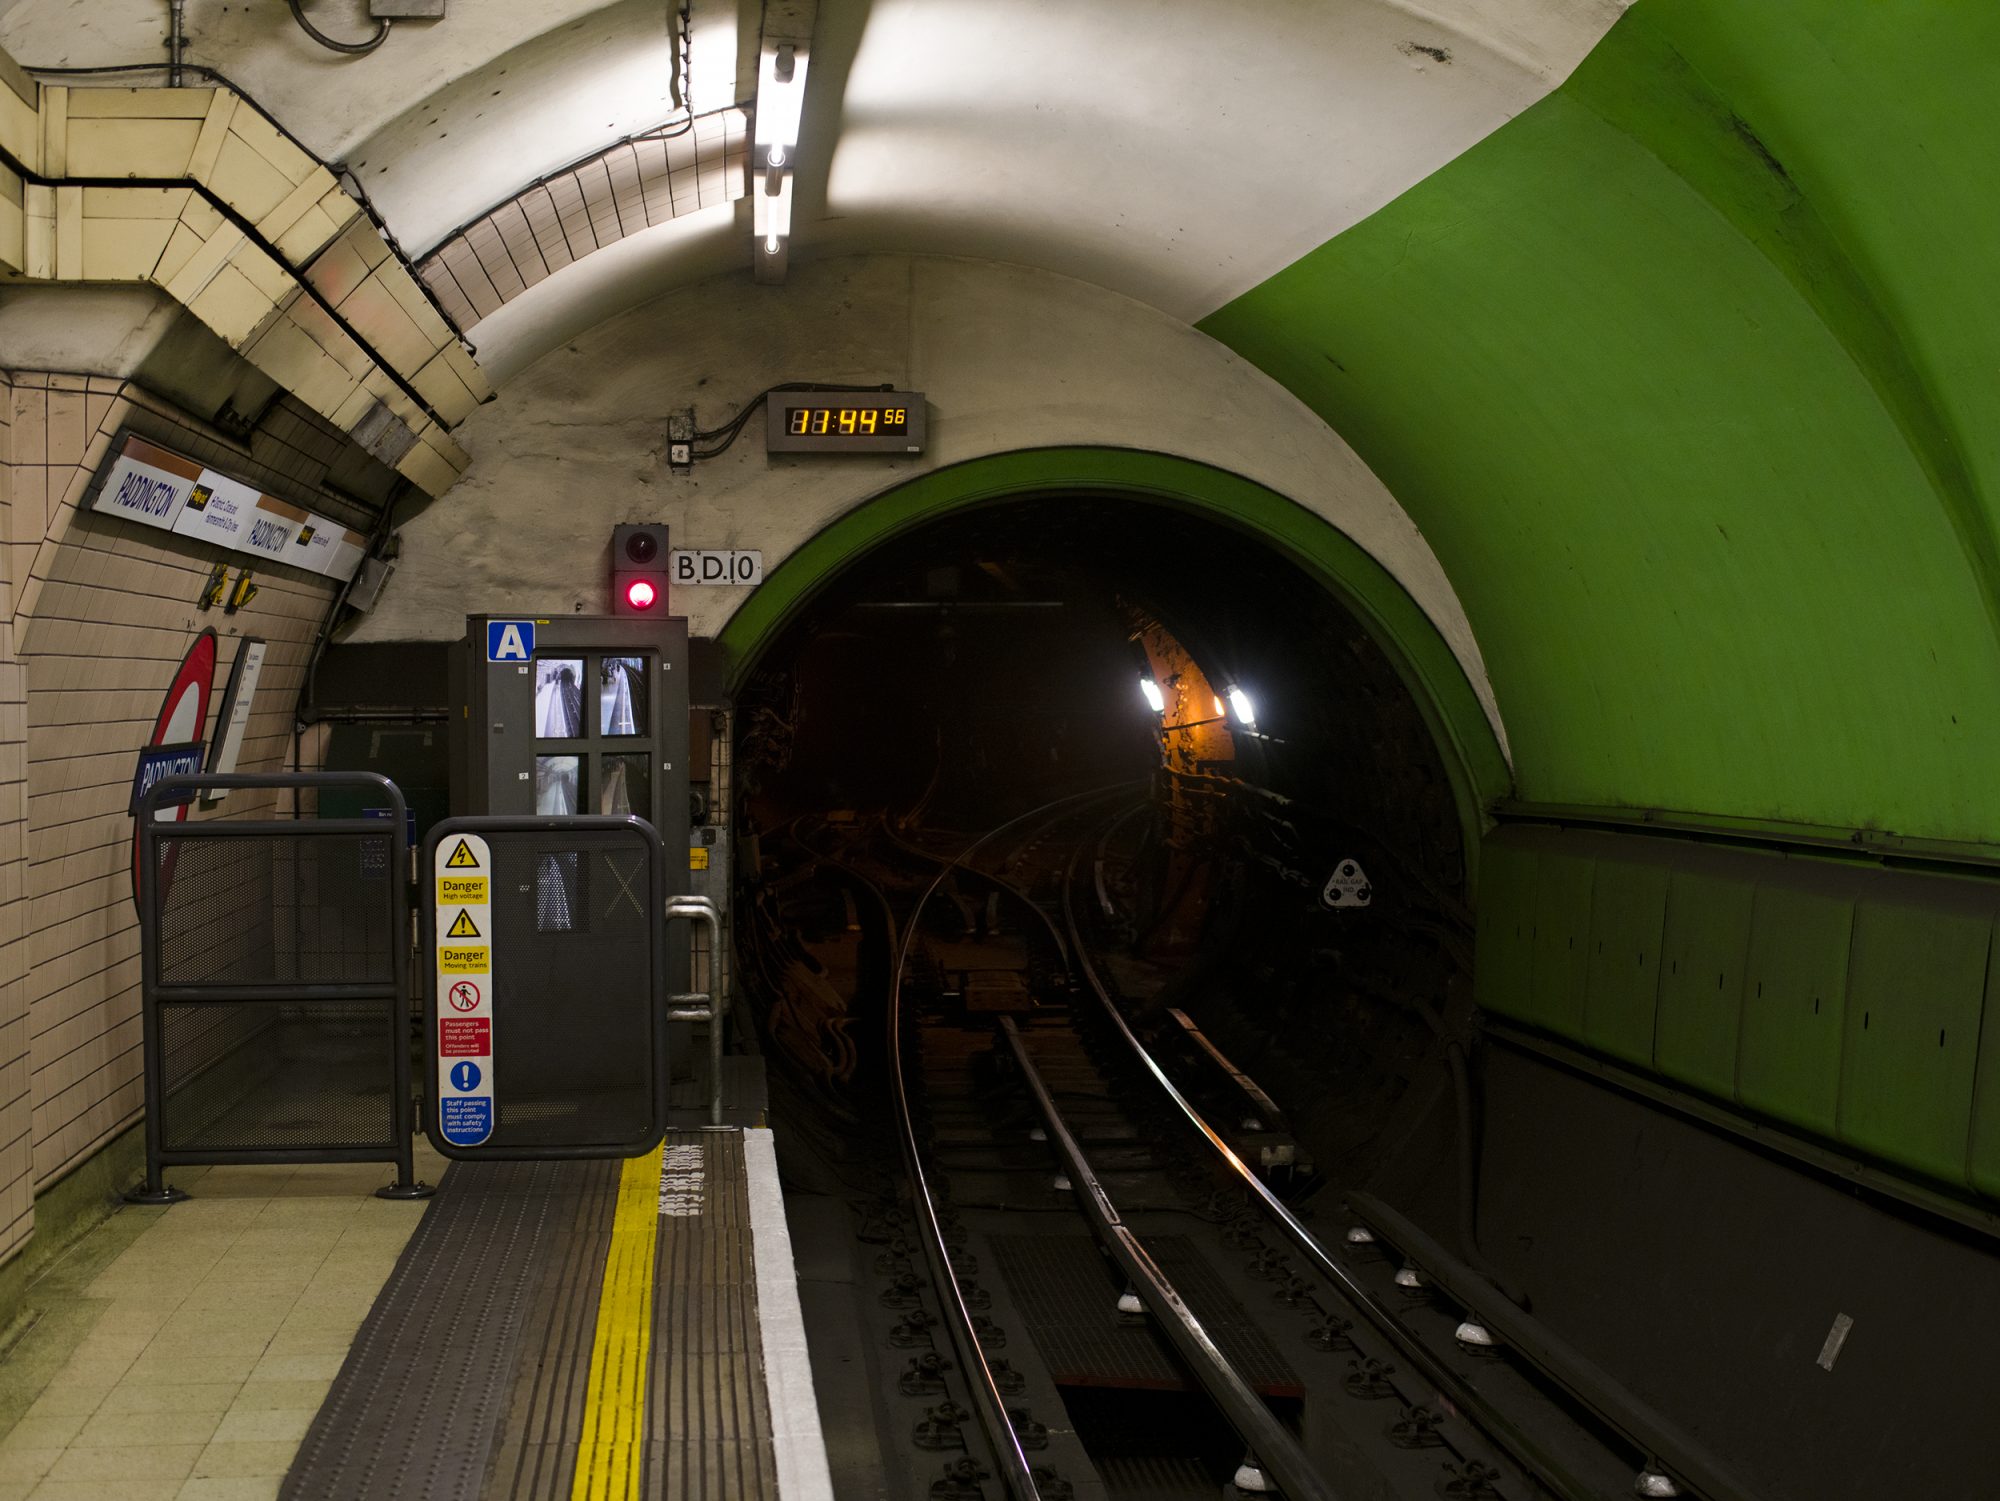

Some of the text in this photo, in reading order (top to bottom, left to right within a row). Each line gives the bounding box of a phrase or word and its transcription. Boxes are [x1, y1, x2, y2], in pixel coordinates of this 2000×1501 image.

[799, 409, 905, 434] 11:44 56
[113, 472, 179, 518] PADDINGTON
[247, 519, 292, 553] PADDINGTON
[496, 625, 527, 659] A
[444, 881, 484, 893] Danger
[445, 951, 484, 962] Danger
